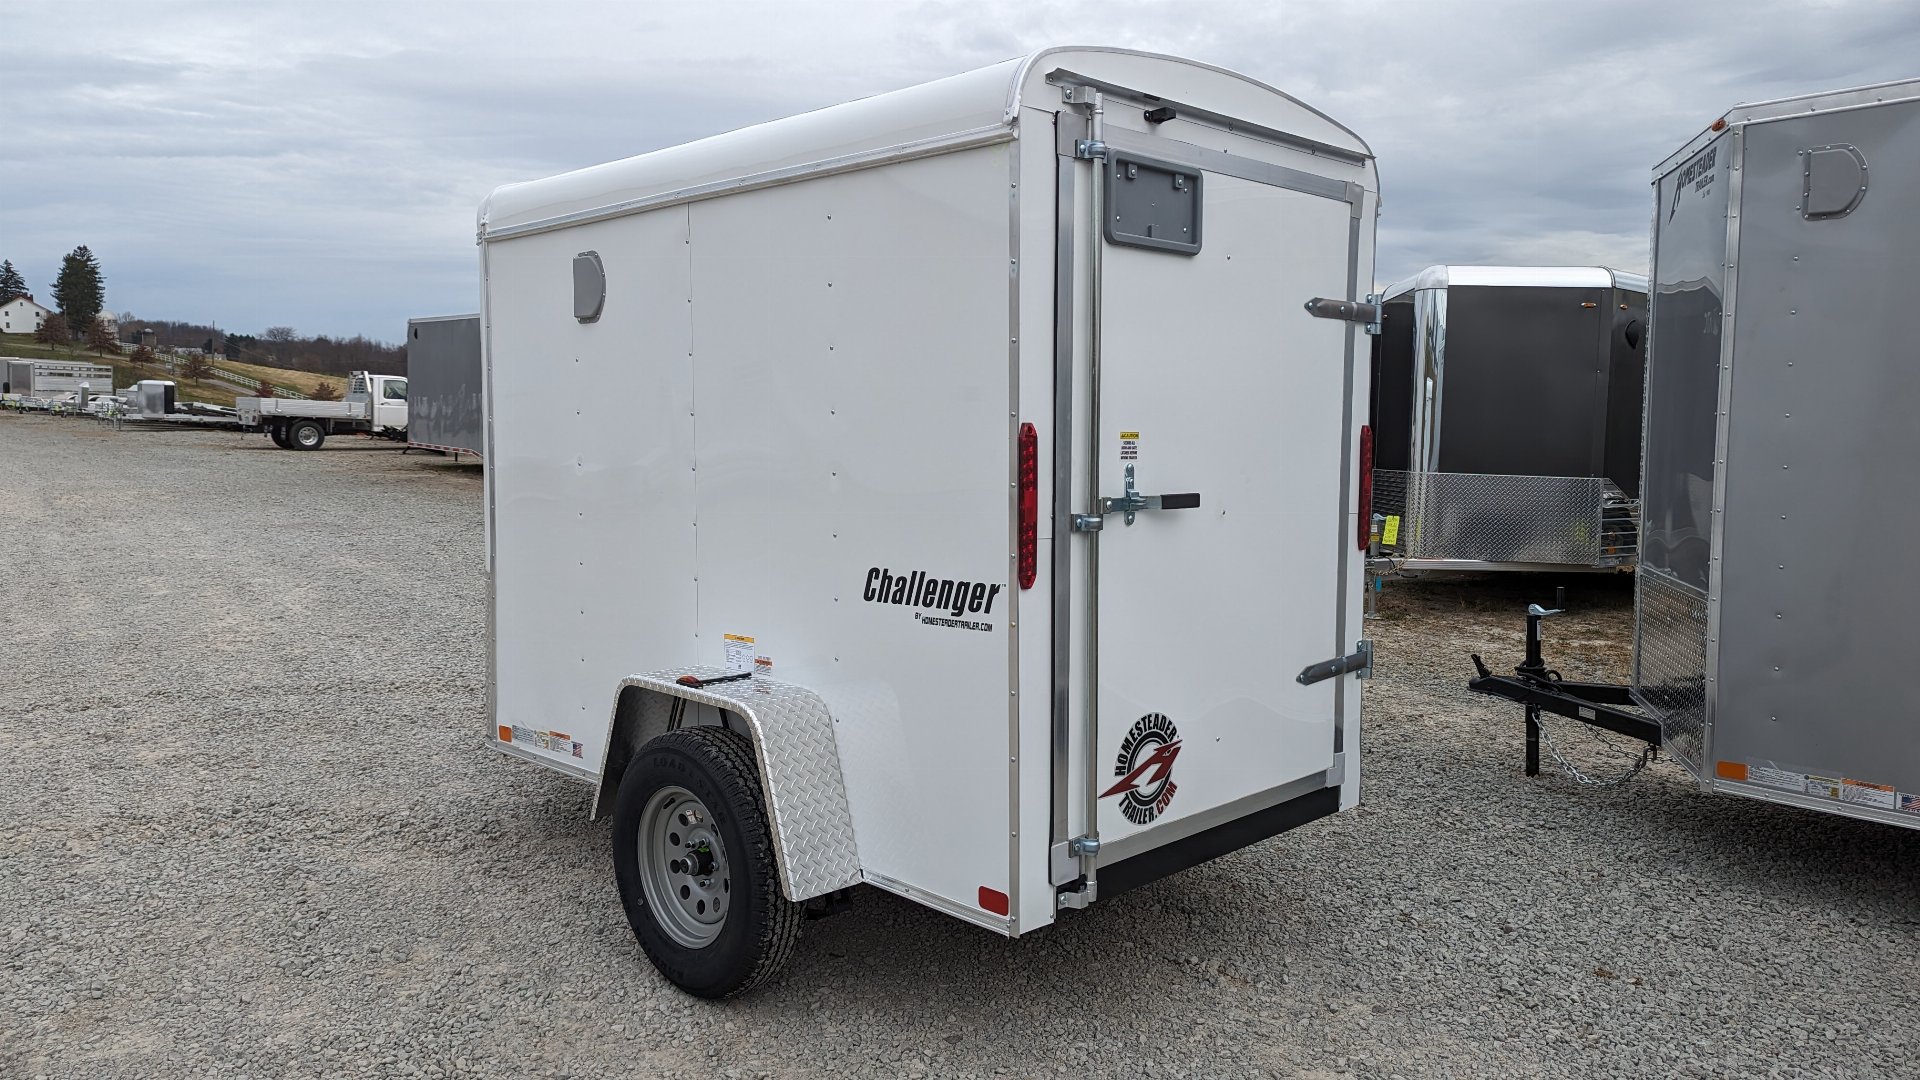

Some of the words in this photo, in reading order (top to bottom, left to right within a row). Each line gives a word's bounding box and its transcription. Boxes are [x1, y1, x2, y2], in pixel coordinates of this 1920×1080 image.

[863, 567, 1001, 617] Challenger
[914, 612, 922, 620] BY
[921, 616, 993, 632] HOMESTEADERTRAILER.COM
[1114, 713, 1178, 776] HOMESTEADER
